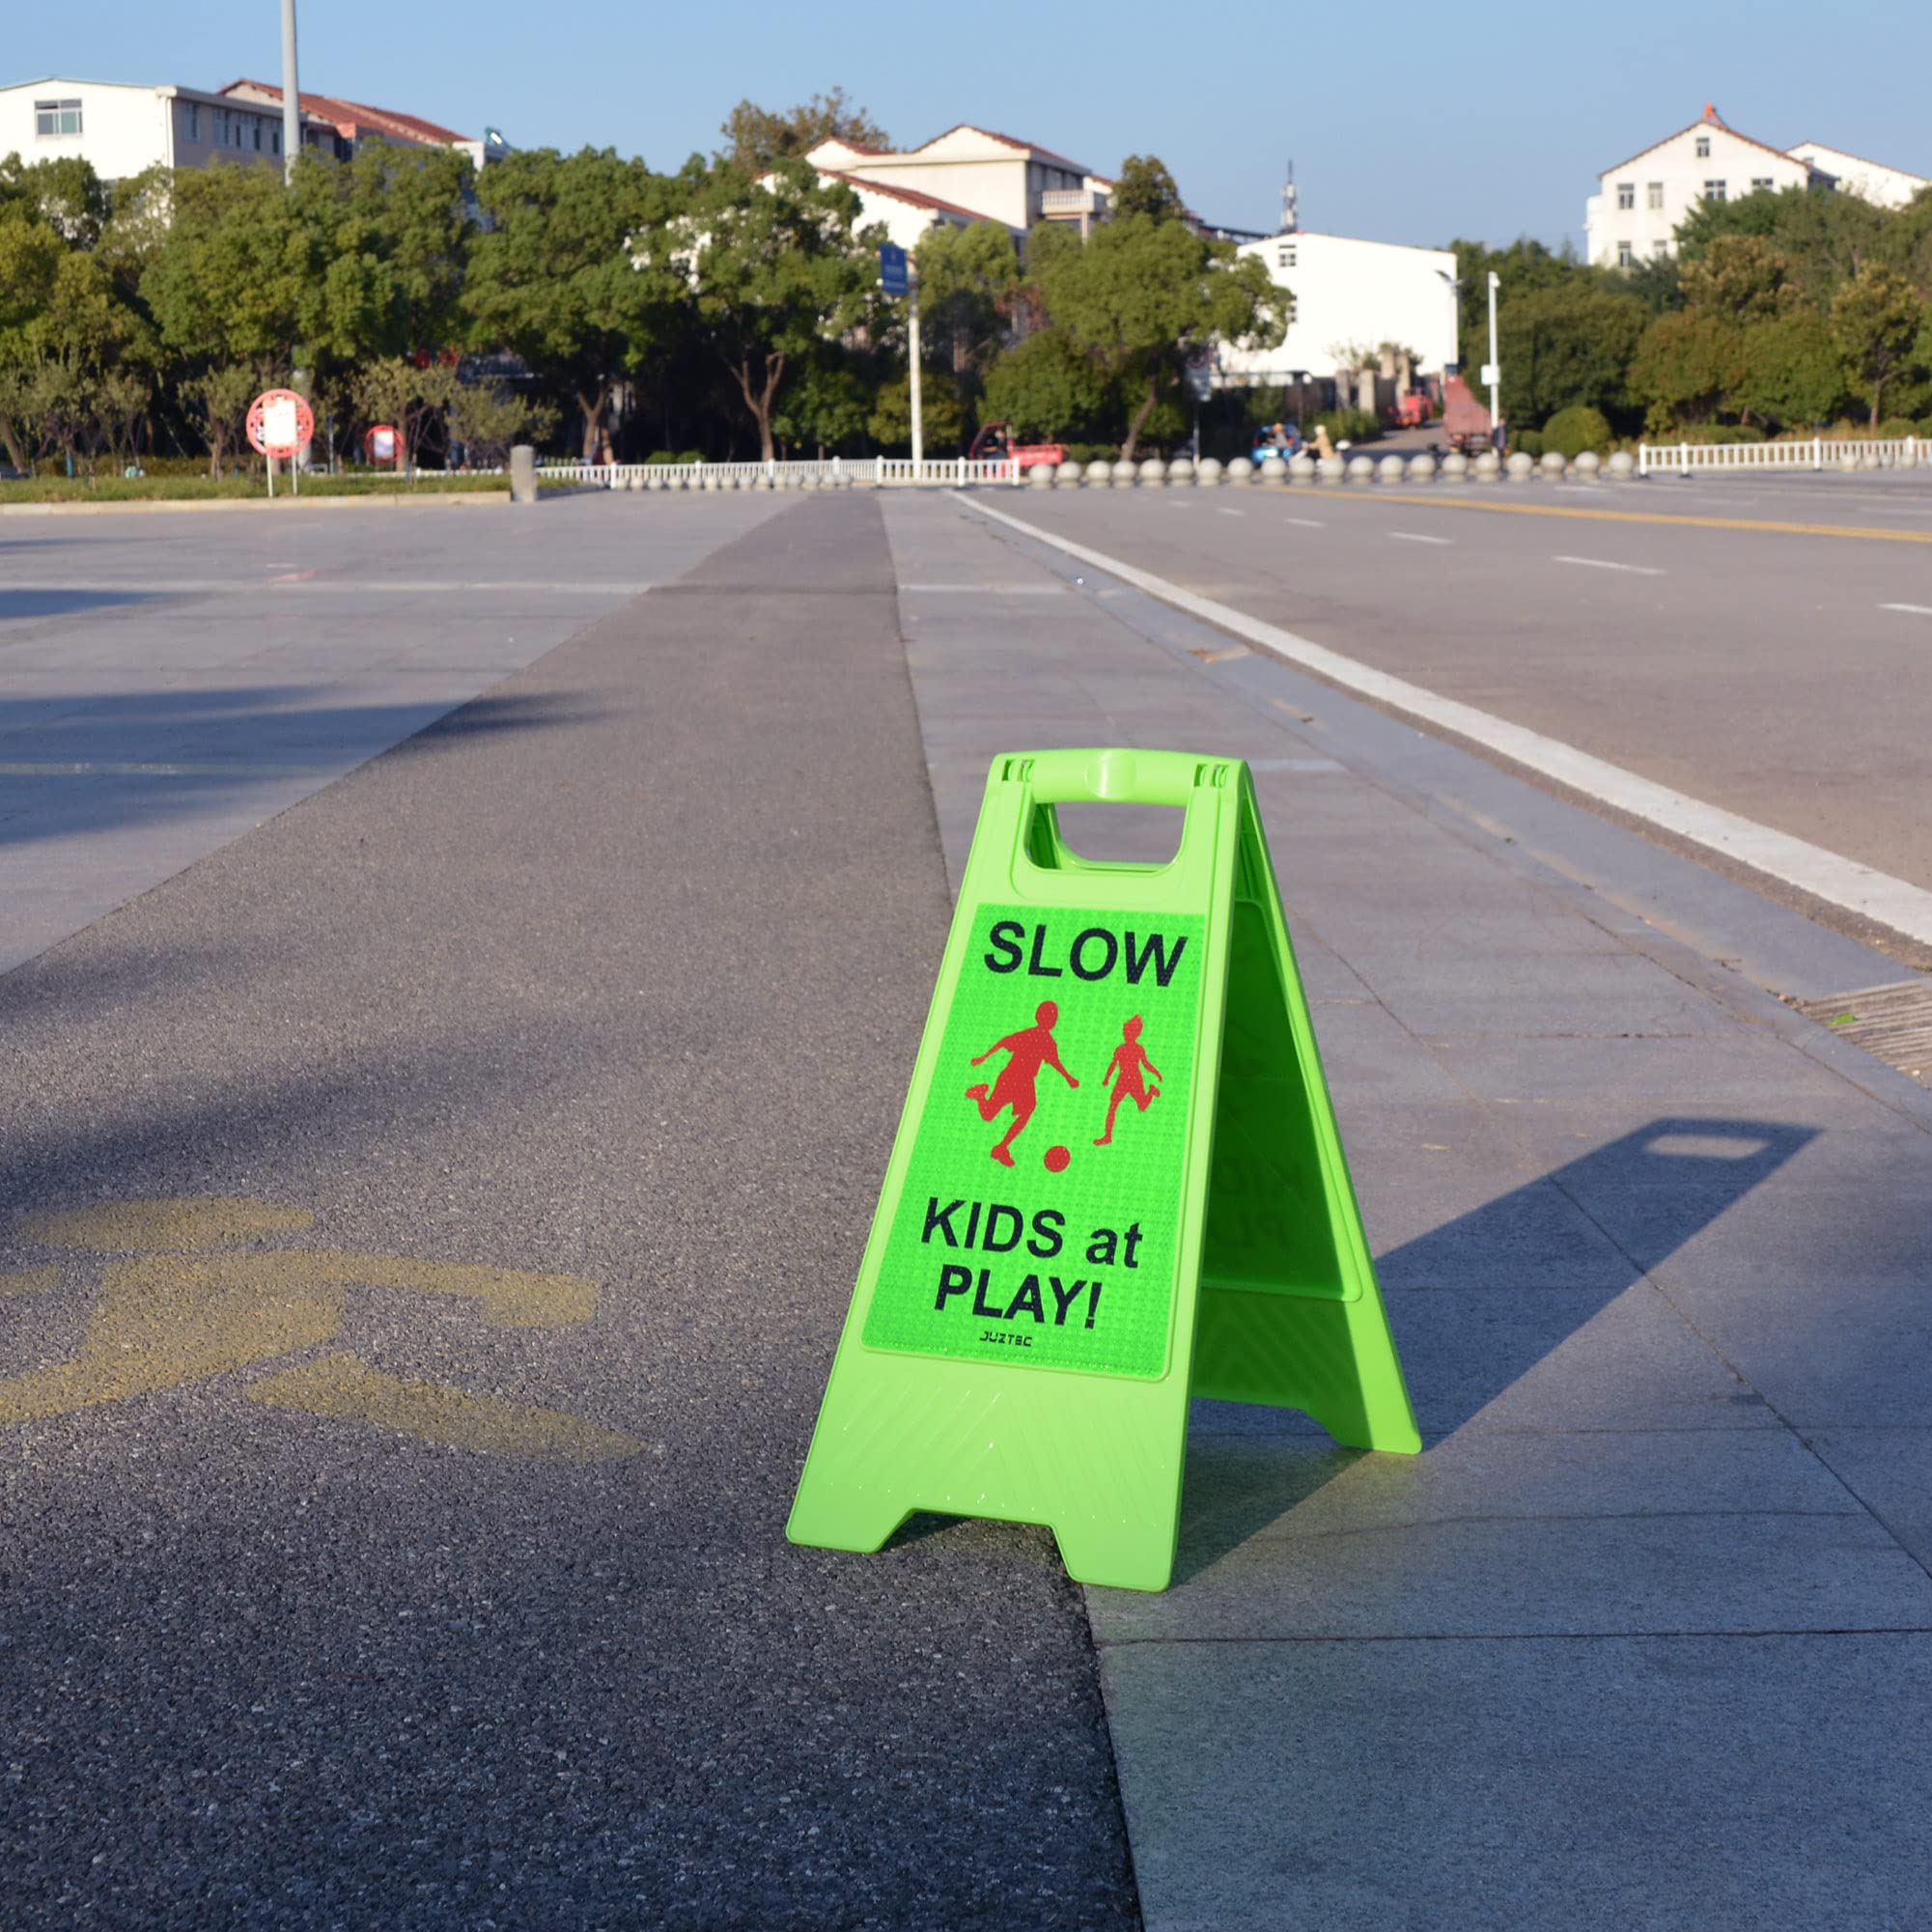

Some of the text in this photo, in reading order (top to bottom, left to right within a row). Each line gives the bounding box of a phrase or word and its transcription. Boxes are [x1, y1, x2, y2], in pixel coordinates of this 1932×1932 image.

[984, 920, 1188, 987] SLOW
[921, 1196, 1066, 1258] KIDS
[1085, 1222, 1143, 1269] at
[934, 1264, 1103, 1330] PLAY!
[979, 1330, 1033, 1348] JUZTEC
